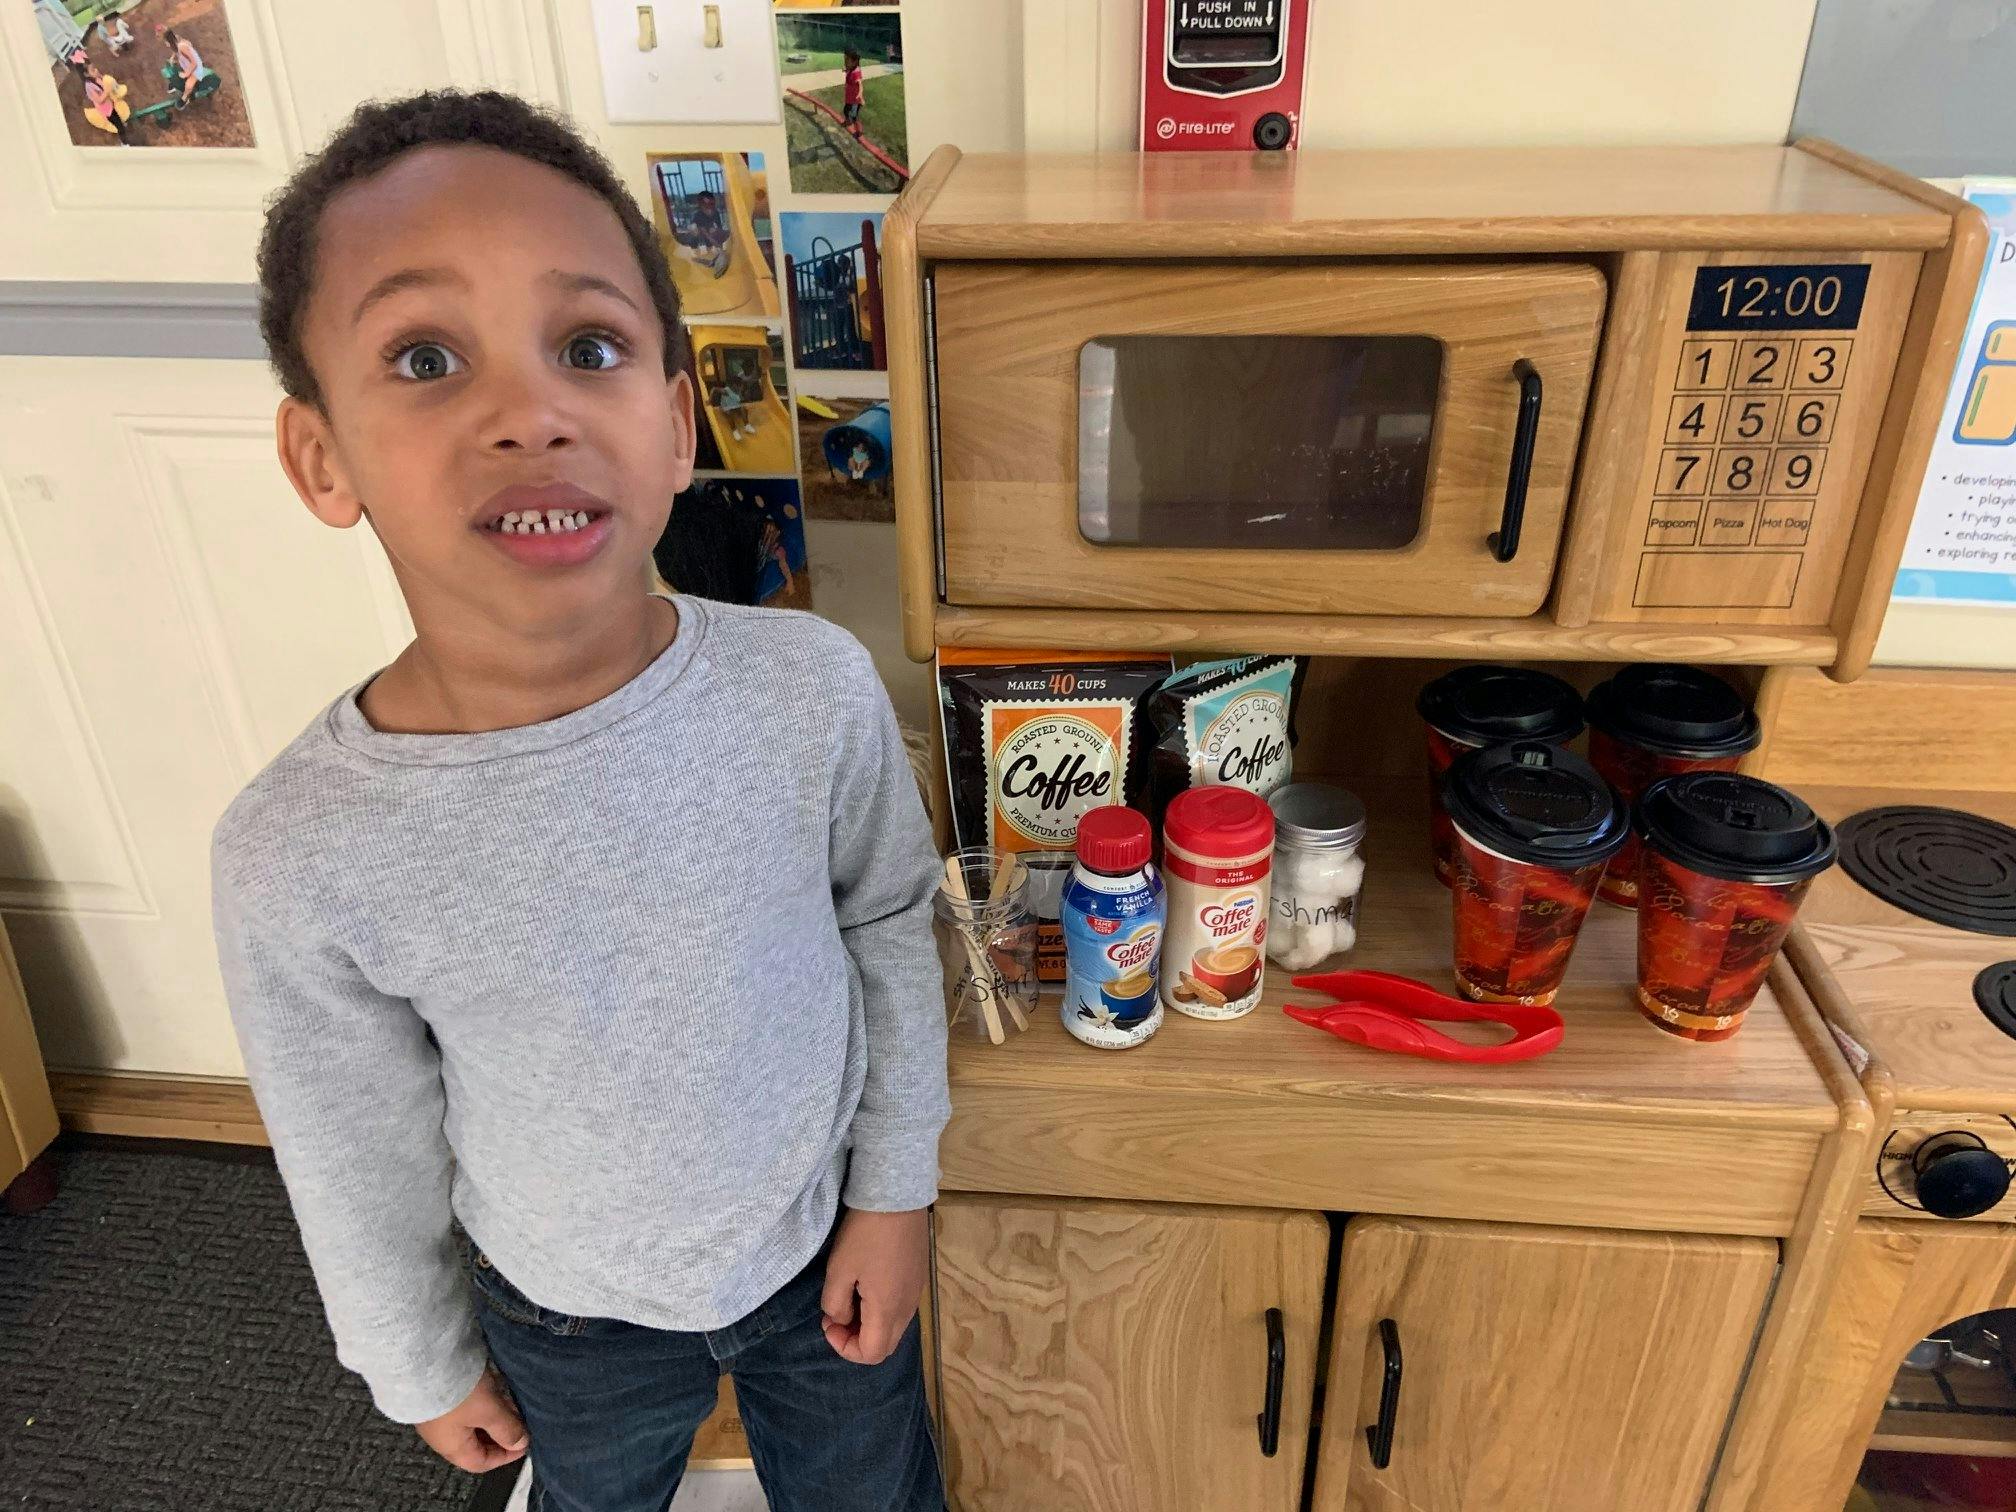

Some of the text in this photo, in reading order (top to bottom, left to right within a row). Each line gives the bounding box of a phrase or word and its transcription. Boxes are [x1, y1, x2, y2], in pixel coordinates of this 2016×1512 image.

[1198, 1, 1256, 13] PUSH IN
[1190, 17, 1262, 29] PULL DOWN
[1717, 277, 1842, 318] 12:00
[1694, 347, 1836, 384] 1 2 3
[1679, 401, 1824, 437] 4 5 6
[1675, 455, 1812, 490] 7 8 9
[1651, 519, 1697, 530] Popcorn
[1714, 518, 1744, 528] Pizza
[1761, 518, 1808, 531] Hot Dog
[1961, 510, 2001, 527] trying
[1938, 547, 1998, 564] exploring
[1007, 674, 1107, 695] MAKES 40 CUPS
[1012, 725, 1106, 754] ROASTED GROUND
[1218, 735, 1284, 784] Coffee
[1002, 754, 1111, 810] Coffee
[1011, 808, 1059, 838] PREMIUM
[1215, 874, 1254, 884] ORIGINAL
[1116, 890, 1150, 904] FRENCH
[1116, 897, 1153, 911] VANILLA
[1200, 904, 1254, 928] Coffee
[1213, 918, 1251, 937] mate
[1107, 937, 1155, 961] Coffee
[1119, 947, 1152, 968] mate
